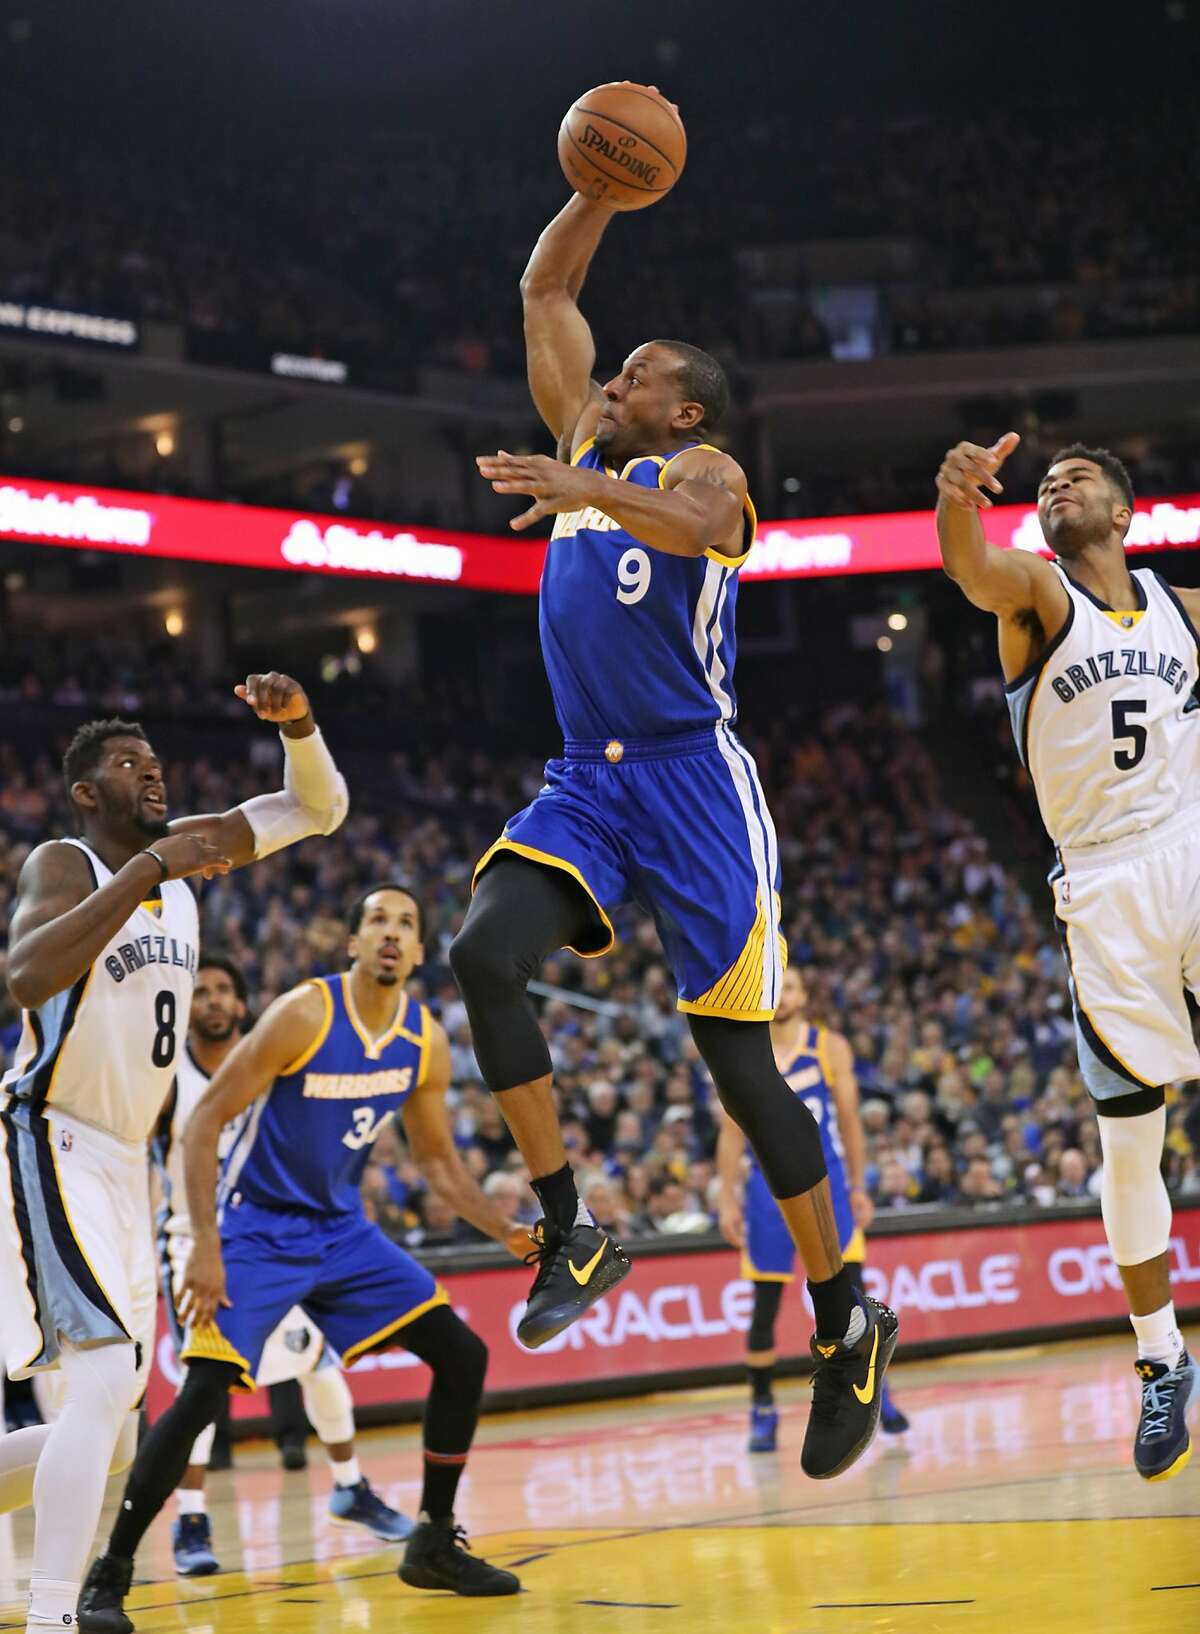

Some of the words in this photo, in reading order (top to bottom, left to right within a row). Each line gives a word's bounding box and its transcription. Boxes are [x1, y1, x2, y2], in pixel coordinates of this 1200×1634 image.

[578, 123, 661, 188] SPALDING
[616, 547, 652, 605] 9
[1051, 649, 1189, 703] GRIZZLIES
[1111, 699, 1147, 771] 5
[105, 935, 196, 983] GRIZZLI
[151, 989, 176, 1069] 8
